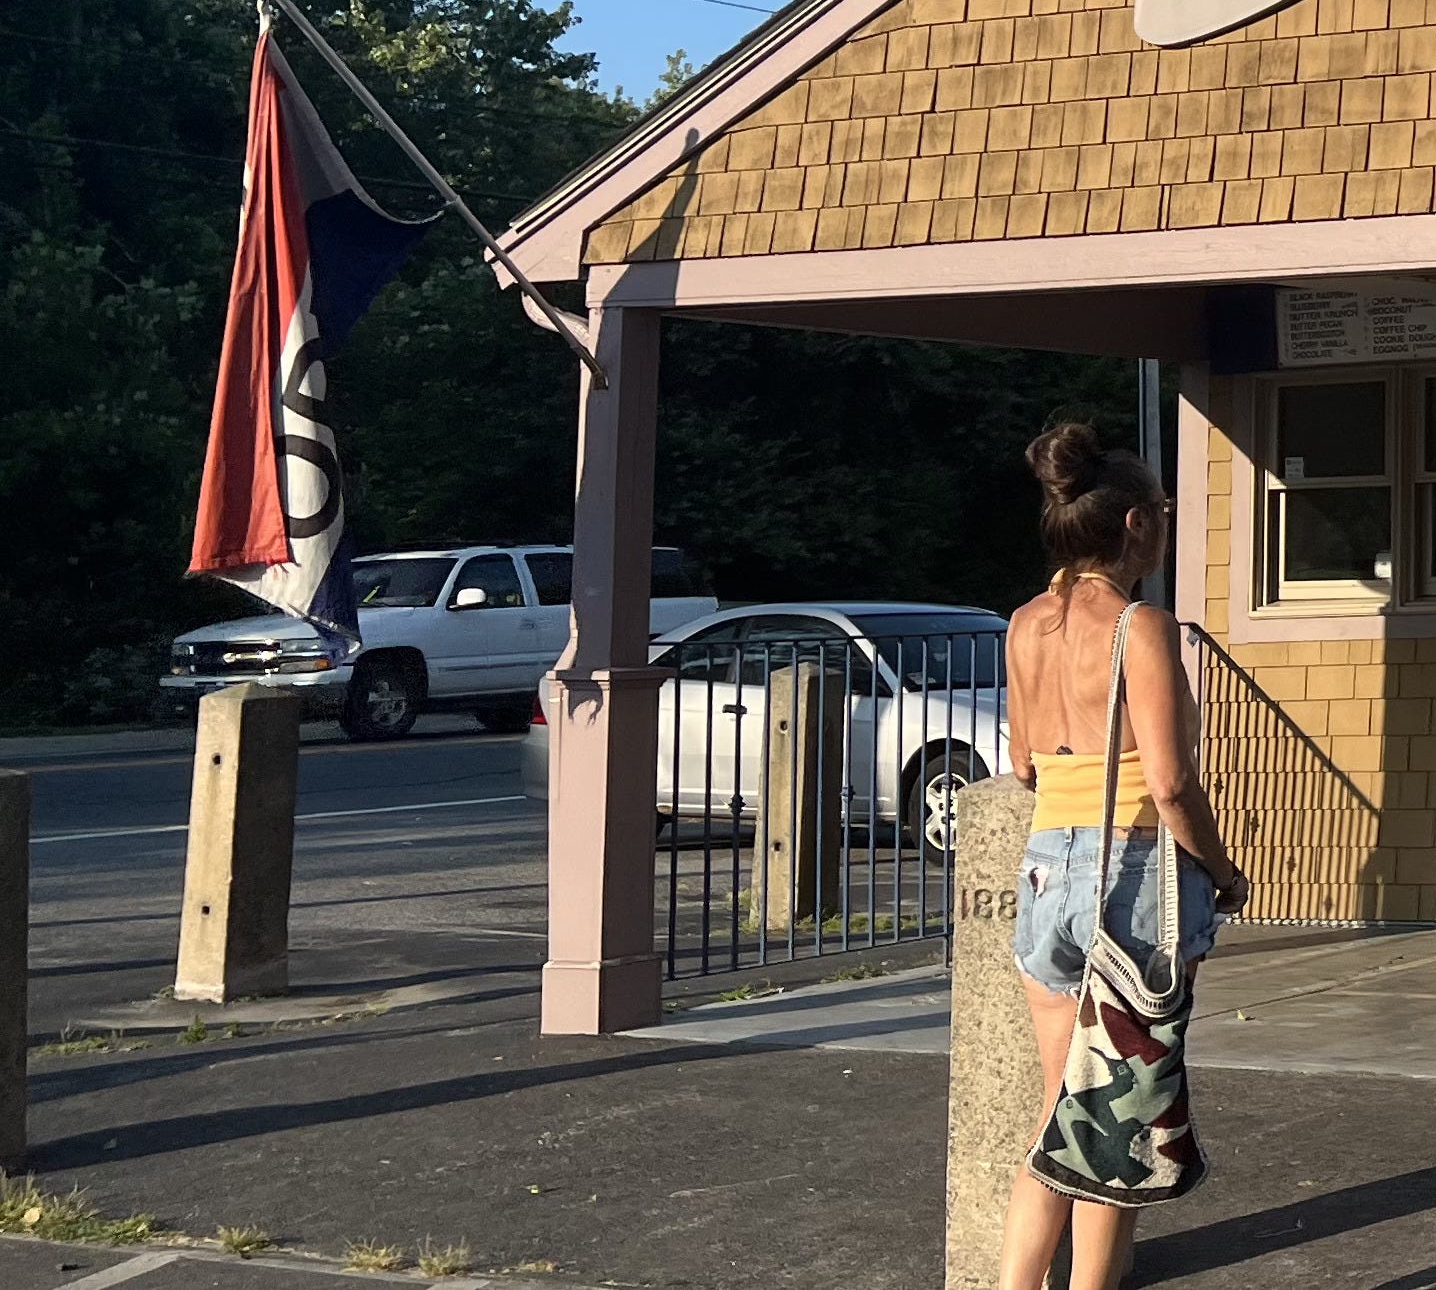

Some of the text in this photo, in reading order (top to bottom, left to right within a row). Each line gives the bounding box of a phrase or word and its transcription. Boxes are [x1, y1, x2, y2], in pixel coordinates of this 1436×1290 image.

[1372, 306, 1412, 315] COCONUT
[1373, 316, 1405, 325] COFFEE
[1373, 324, 1427, 335] COFFEE CHIP
[1373, 335, 1405, 344] COOKIE
[1373, 345, 1409, 355] EGGNOG
